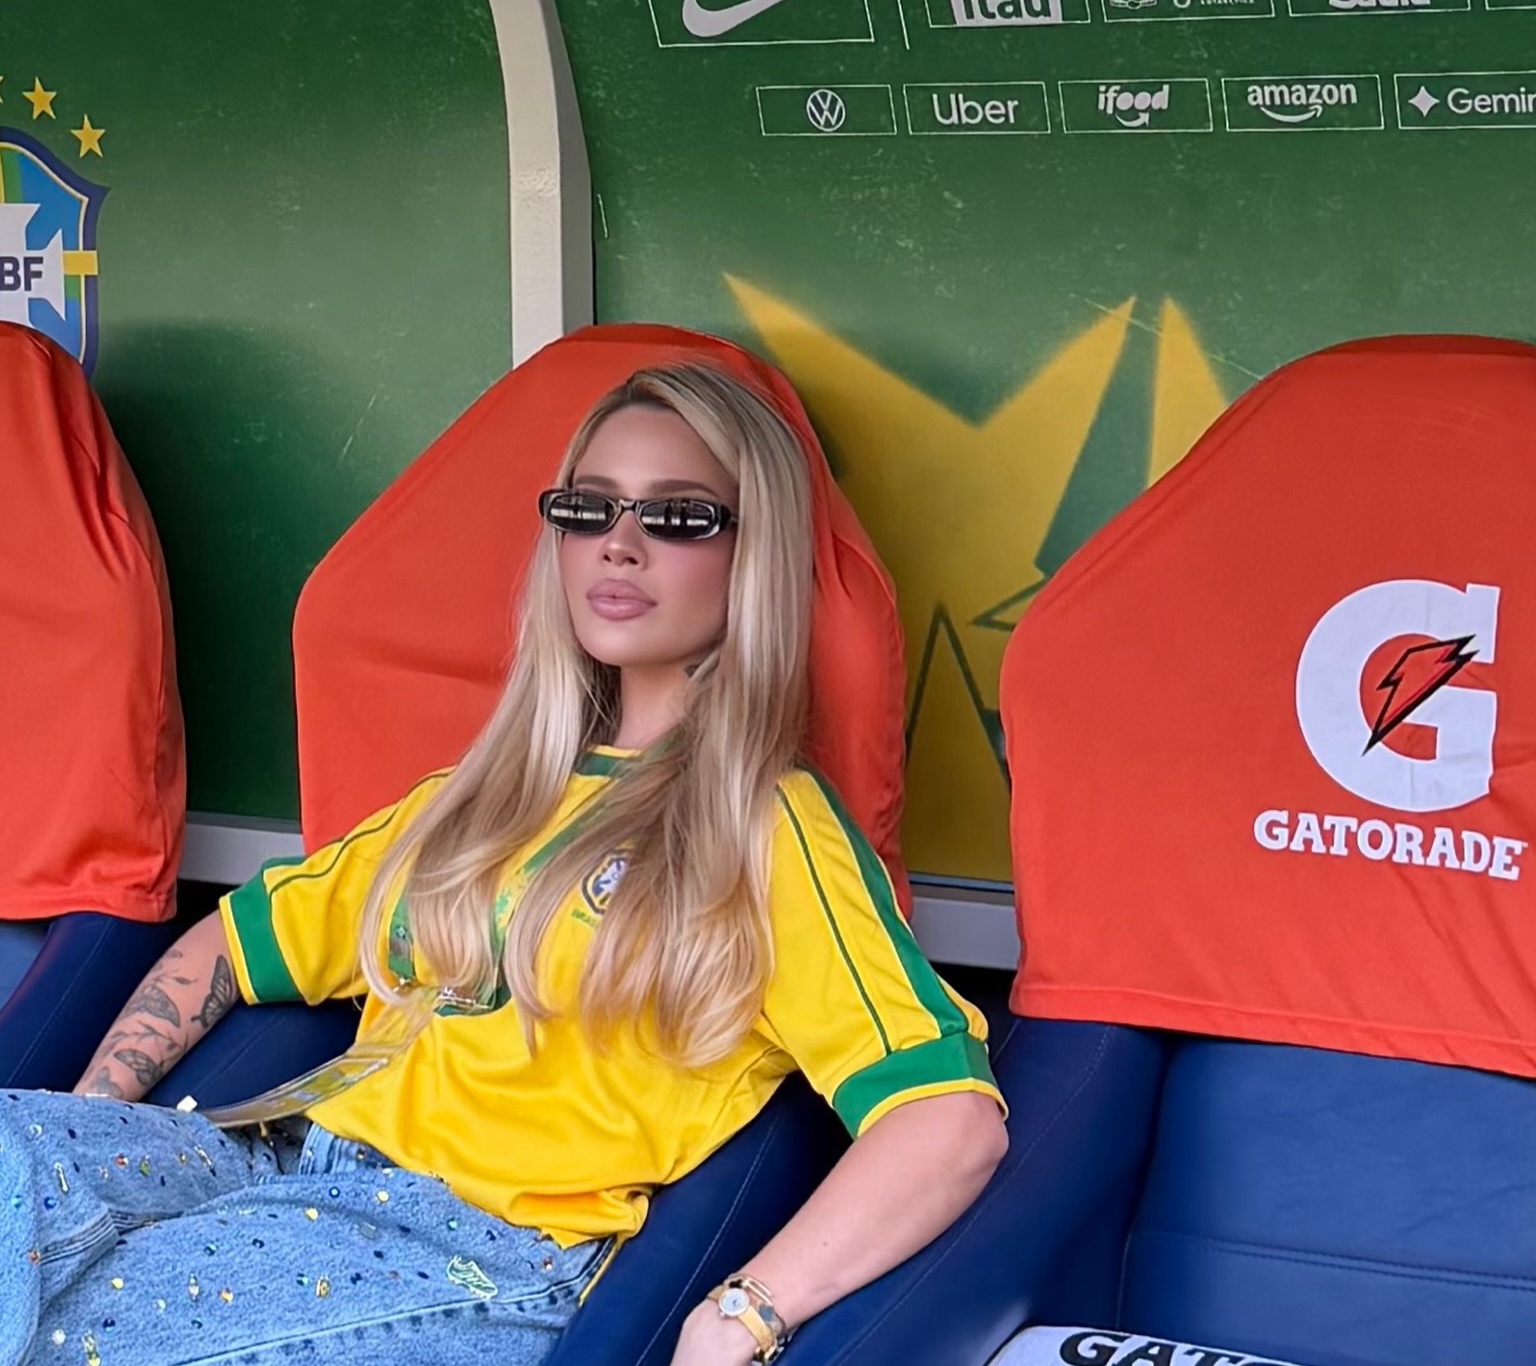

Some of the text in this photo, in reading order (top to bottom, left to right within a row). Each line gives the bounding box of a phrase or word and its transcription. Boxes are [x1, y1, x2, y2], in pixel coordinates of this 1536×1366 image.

[932, 93, 1019, 126] Uber
[1098, 84, 1170, 115] ifood
[1247, 83, 1358, 106] amazon
[1253, 809, 1527, 881] GATORADE
